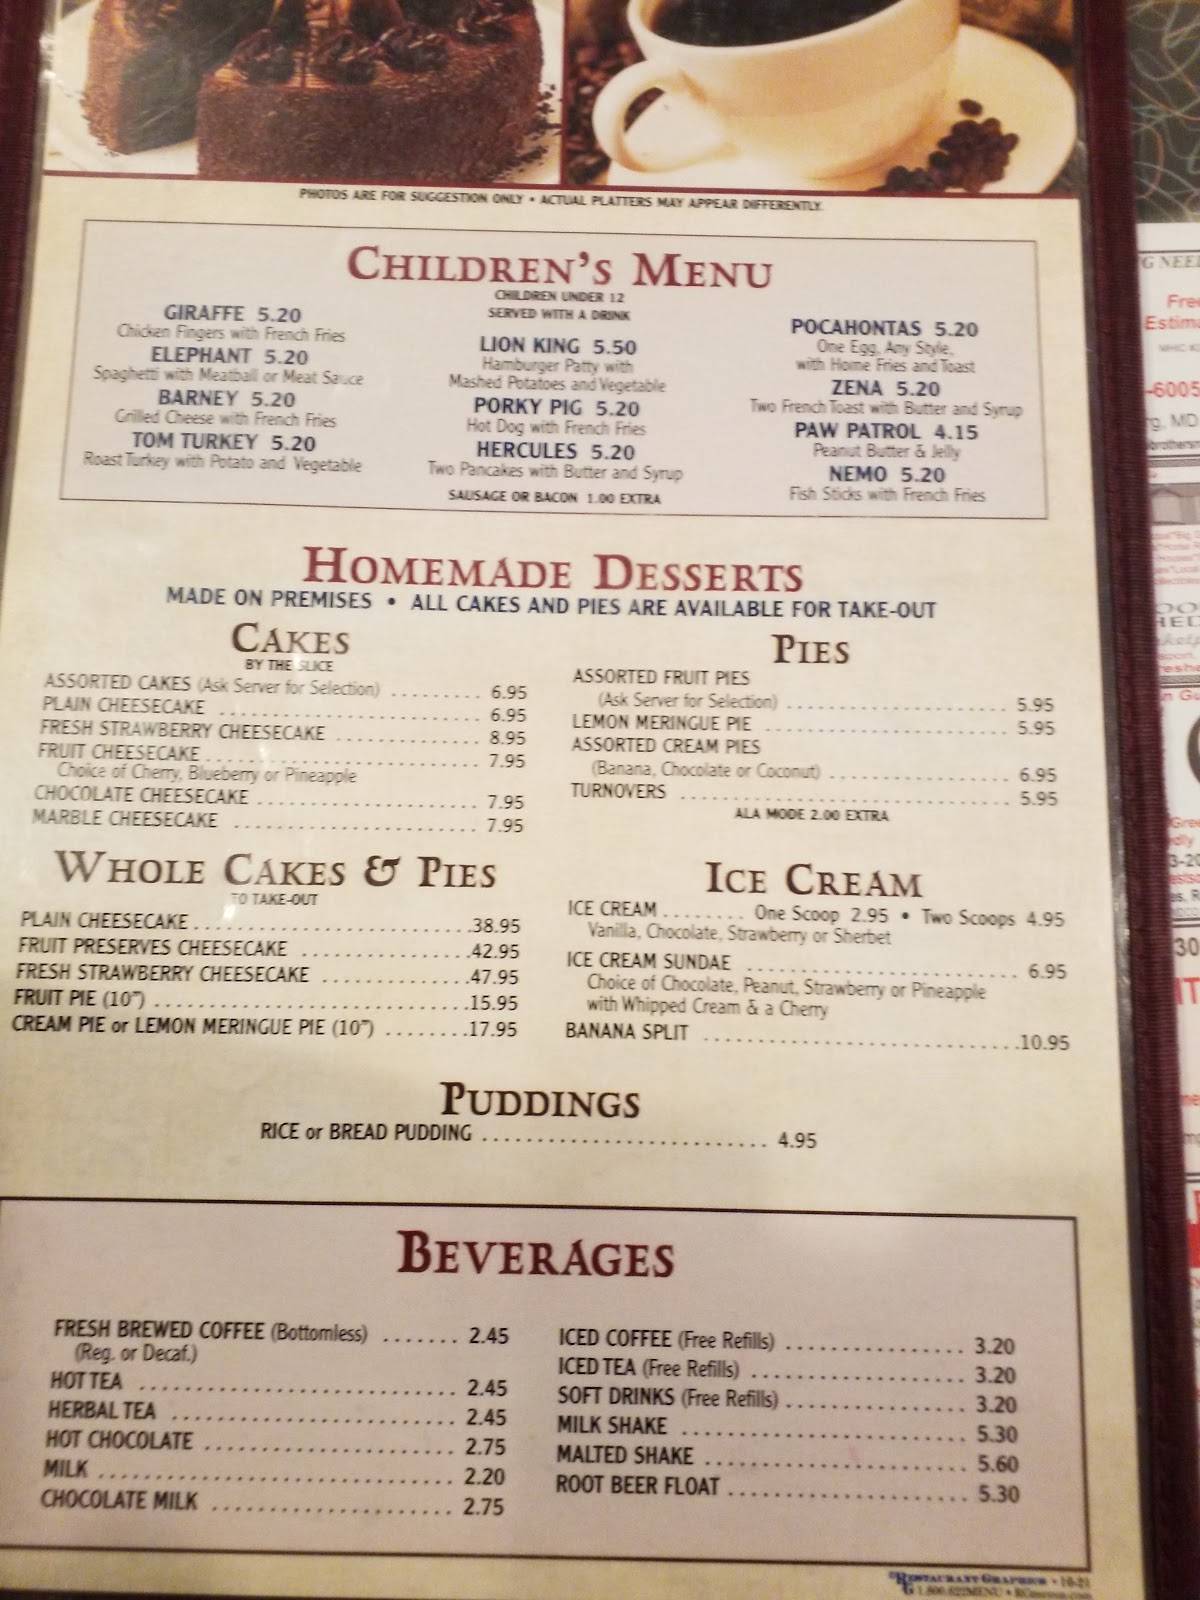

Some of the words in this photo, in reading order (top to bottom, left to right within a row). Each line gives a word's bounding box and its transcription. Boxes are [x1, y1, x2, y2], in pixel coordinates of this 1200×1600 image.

[299, 188, 348, 199] PHOTOS
[353, 190, 376, 200] ARE
[381, 190, 405, 200] FOR
[410, 191, 488, 203] SUGGESTION
[492, 193, 522, 204] ONLY
[540, 194, 586, 205] ACTUAL
[591, 195, 652, 207] PLATTERS
[656, 196, 684, 208] MAY
[688, 197, 738, 209] APPEAR
[633, 252, 773, 288] MENU
[1157, 255, 1200, 269] NEE
[494, 289, 557, 301] CHILDREN
[560, 291, 604, 302] UNDER
[610, 292, 624, 302] 12
[163, 303, 244, 321] GIRAFFE
[258, 306, 301, 323] 5.20
[488, 307, 537, 318] SERVED
[540, 308, 574, 319] WITH
[577, 309, 586, 319] A
[590, 309, 630, 320] DRINK
[116, 322, 170, 338] Chicken
[175, 323, 225, 342] Fingers
[230, 326, 260, 340] with
[264, 325, 310, 341] French
[313, 327, 346, 342] Fries
[791, 318, 921, 336] POCAHONTAS
[934, 321, 978, 337] 5.20
[150, 346, 250, 363] ELEPHANT
[264, 349, 308, 365] 5.20
[480, 335, 525, 352] LION
[532, 337, 580, 354] KING
[593, 339, 636, 355] 5.50
[157, 388, 237, 406] BARNEY
[251, 391, 295, 407] 5.20
[832, 379, 883, 396] ZENA
[896, 380, 940, 396] 5.20
[133, 431, 173, 448] TOM
[181, 432, 257, 450] TURKEY
[271, 434, 316, 451] 5.20
[795, 421, 838, 438] PAW
[846, 422, 920, 439] PATROL
[934, 424, 978, 440] 4.15
[476, 440, 577, 459] HERCULES
[591, 444, 634, 460] 5.20
[829, 464, 887, 482] NEMO
[901, 466, 945, 482] 5.20
[447, 489, 506, 502] SAUSAGE
[511, 490, 530, 503] OR
[534, 491, 578, 504] BACON
[588, 492, 615, 504] 1.00
[620, 493, 662, 505] EXTRA
[789, 485, 817, 500] Fish
[822, 485, 862, 501] Sticks
[867, 487, 898, 501] with
[902, 486, 948, 501] French
[953, 487, 986, 502] Fries
[303, 546, 570, 588] HOMEMADE
[594, 553, 802, 594] DESSERTS
[167, 586, 225, 604] MADE
[234, 588, 262, 606] ON
[271, 590, 371, 609] PREMISES
[411, 593, 447, 611] ALL
[456, 594, 520, 612] CAKES
[528, 596, 569, 613] AND
[577, 597, 620, 614] PIES
[629, 598, 666, 615] ARE
[675, 598, 783, 617] AVAILABLE
[792, 600, 830, 617] FOR
[838, 600, 935, 619] TAKE-OUT
[231, 621, 349, 655] CAKES
[773, 634, 848, 664] PIES
[573, 668, 657, 684] ASSORTED
[663, 669, 708, 684] FRUIT
[715, 670, 750, 685] PIES
[40, 718, 93, 735] FRESH
[99, 720, 212, 738] STRAWBERRY
[218, 723, 325, 741] CHEESECAKE
[489, 730, 525, 745] 8.95
[572, 713, 629, 729] LEMON
[635, 714, 719, 730] MERINGUE
[726, 716, 751, 731] PIE
[1017, 720, 1055, 735] 5.95
[34, 784, 133, 802] CHOCOLATE
[139, 786, 248, 804] CHEESECAKE
[488, 794, 524, 809] 7.95
[571, 782, 666, 799] TURNOVERS
[1020, 790, 1058, 806] 5.95
[735, 807, 760, 819] ALA
[765, 808, 804, 820] MODE
[810, 809, 840, 820] 2.00
[845, 809, 888, 821] EXTRA
[55, 850, 204, 884] WHOLE
[224, 853, 345, 886] CAKES
[364, 854, 400, 886] &
[418, 856, 495, 888] PIES
[707, 861, 766, 893] ICE
[785, 863, 921, 897] CREAM
[754, 904, 785, 920] One
[791, 904, 840, 925] Scoop
[851, 907, 888, 923] 2.95
[922, 908, 952, 924] Two
[959, 908, 1015, 929] Scoops
[1026, 911, 1064, 927] 4.95
[18, 936, 67, 953] FRUIT
[73, 937, 171, 955] PRESERVES
[177, 939, 287, 957] CHEESECAKE
[472, 943, 519, 959] 42.95
[16, 962, 70, 979] FRESH
[77, 963, 193, 981] STRAWBERRY
[199, 965, 309, 983] CHEESECAKE
[470, 968, 518, 984] 47.95
[565, 1021, 635, 1038] BANANA
[642, 1023, 688, 1040] SPLIT
[1020, 1034, 1069, 1050] 10.95
[440, 1081, 639, 1117] PUDDINGS
[260, 1122, 299, 1139] RICE
[305, 1127, 322, 1140] or
[329, 1122, 388, 1140] BREAD
[394, 1122, 471, 1141] PUDDING
[778, 1131, 816, 1148] 4.95
[398, 1229, 674, 1276] BEVERAGES
[54, 1318, 110, 1338] FRESH
[117, 1319, 193, 1338] BREWED
[198, 1320, 264, 1340] COFFEE
[271, 1322, 367, 1344] (Bottomless)
[469, 1326, 508, 1344] 2.45
[559, 1327, 599, 1346] ICED
[605, 1328, 671, 1347] COFFEE
[677, 1330, 716, 1350] (Free
[722, 1330, 774, 1352] Refills)
[975, 1336, 1015, 1355] 3.20
[45, 1428, 81, 1448] HOT
[87, 1429, 193, 1450] CHOCOLATE
[465, 1437, 505, 1455] 2.75
[556, 1444, 627, 1464] MALTED
[634, 1445, 693, 1465] SHAKE
[978, 1454, 1019, 1473] 5.60
[555, 1473, 603, 1493] ROOT
[610, 1474, 657, 1494] BEER
[664, 1475, 719, 1496] FLOAT
[978, 1483, 1020, 1503] 5.30
[40, 1488, 146, 1510] CHOCOLATE
[153, 1490, 197, 1510] MILK
[463, 1496, 504, 1516] 2.75
